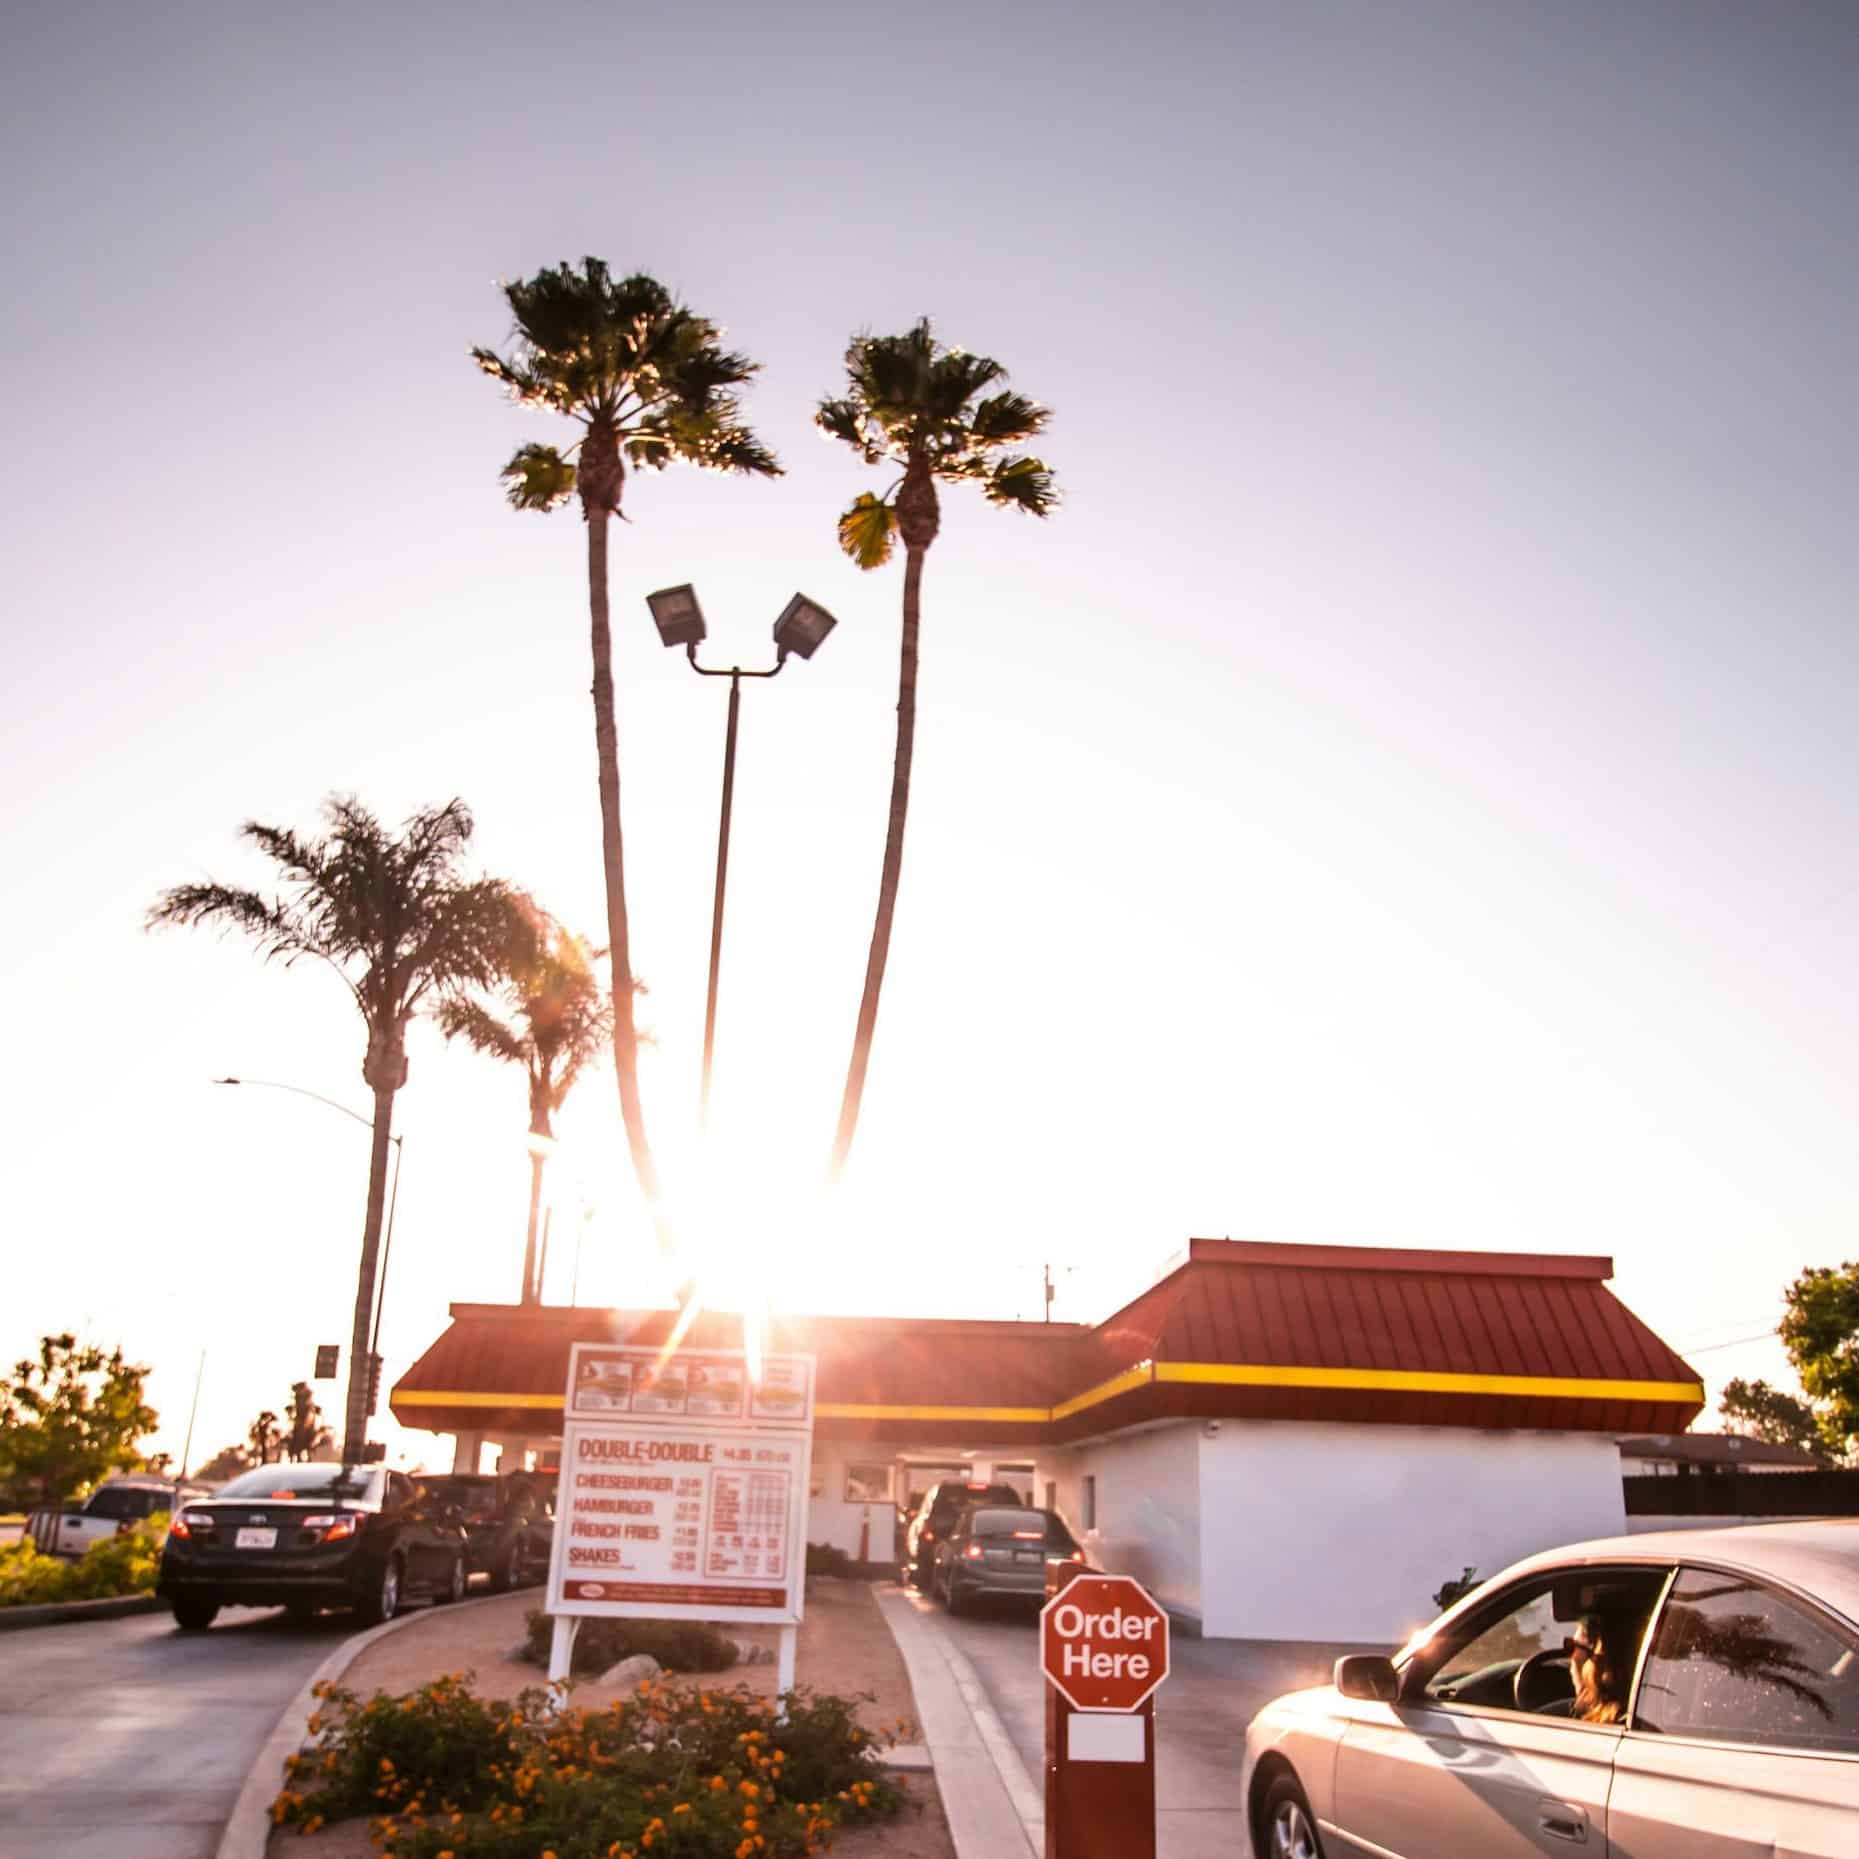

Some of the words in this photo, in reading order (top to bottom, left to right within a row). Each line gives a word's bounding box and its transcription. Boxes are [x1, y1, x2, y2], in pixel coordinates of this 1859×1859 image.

[578, 1439, 713, 1463] DOUBLE-DOUBLE
[576, 1474, 673, 1491] CHEESEBURGER
[574, 1499, 653, 1515] HAMBURGER
[571, 1520, 620, 1538] FRENCH
[624, 1525, 660, 1540] FRIES
[569, 1548, 620, 1562] SHAKES
[1054, 1604, 1159, 1640] Order
[1063, 1643, 1150, 1679] Here
